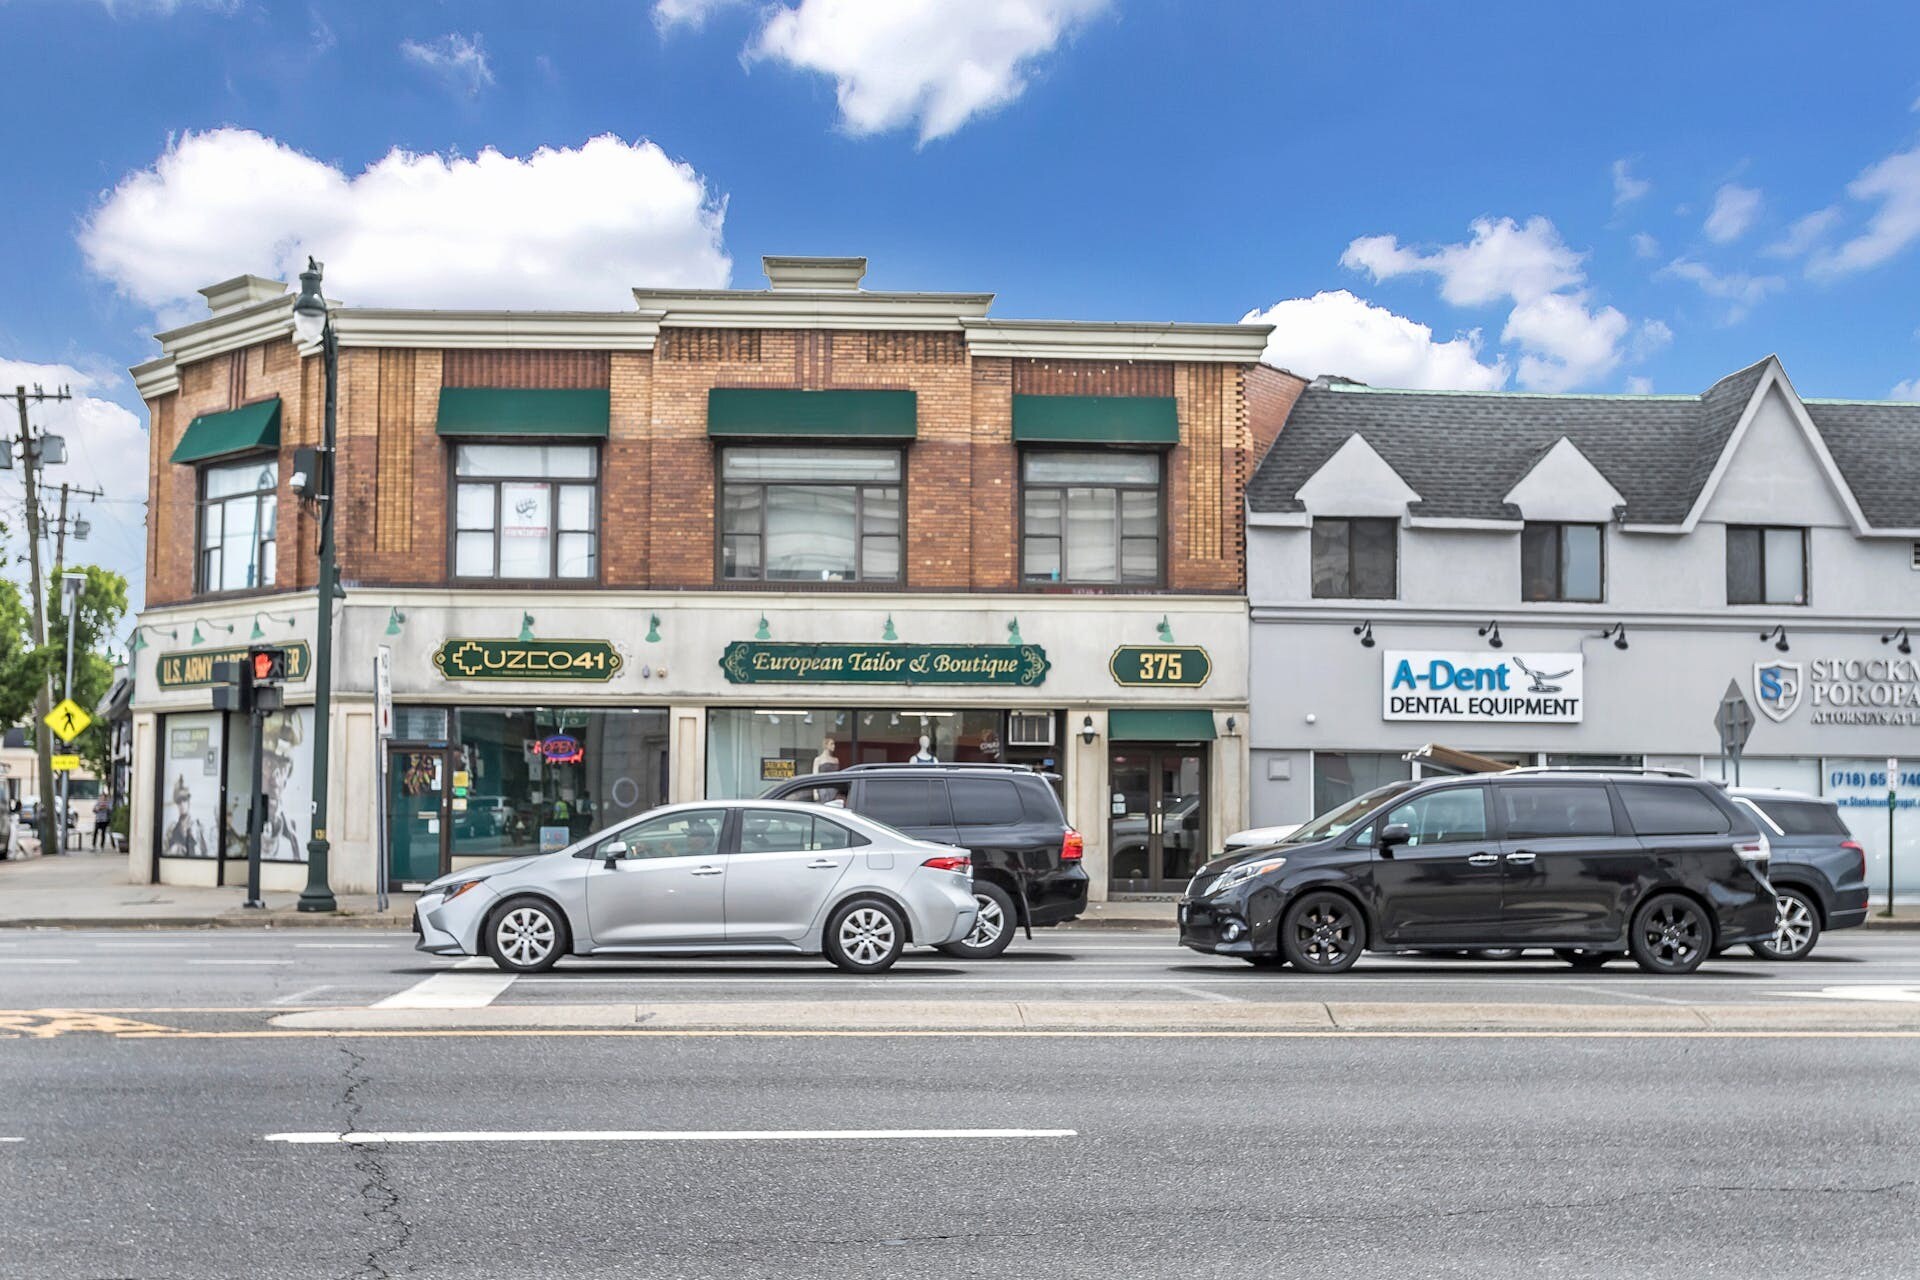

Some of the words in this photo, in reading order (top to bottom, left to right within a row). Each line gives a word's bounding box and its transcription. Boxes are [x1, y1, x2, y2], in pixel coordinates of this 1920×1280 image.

[163, 658, 182, 684] U.S.
[184, 655, 213, 682] ARMY
[752, 651, 843, 675] European
[849, 651, 904, 672] Tailor
[909, 653, 930, 673] &
[933, 653, 1018, 678] Boutique
[1139, 652, 1182, 680] 375
[1391, 658, 1511, 692] A-Dent
[1390, 697, 1463, 715] DENTAL
[1469, 697, 1579, 717] EQUIPMENT
[1831, 772, 1866, 788] (718)
